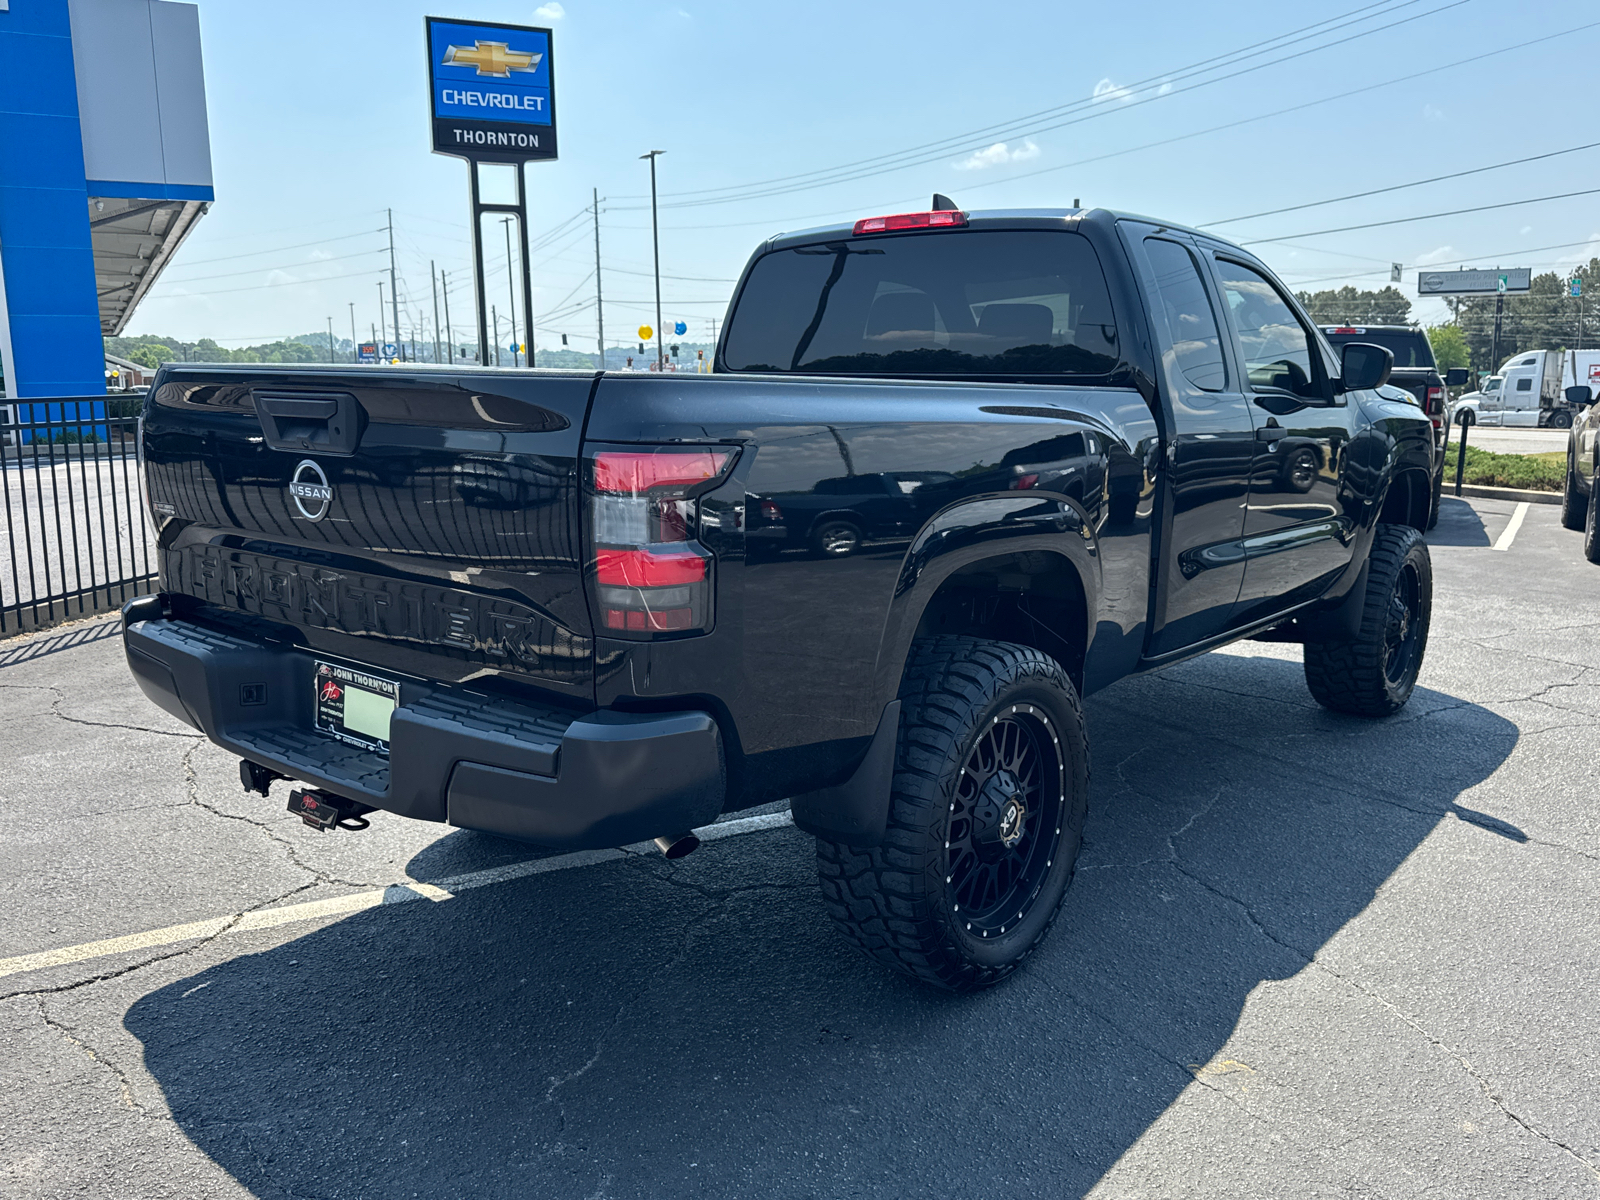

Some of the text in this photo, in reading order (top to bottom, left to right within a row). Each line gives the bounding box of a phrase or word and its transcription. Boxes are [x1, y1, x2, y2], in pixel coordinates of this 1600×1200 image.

[442, 90, 544, 111] CHEVROLET
[453, 129, 539, 148] THORNTON
[290, 483, 331, 499] NISSAN
[191, 551, 540, 664] FRONTIER
[333, 667, 393, 693] JOHN THORNTON
[342, 736, 368, 749] CHEVROLET
